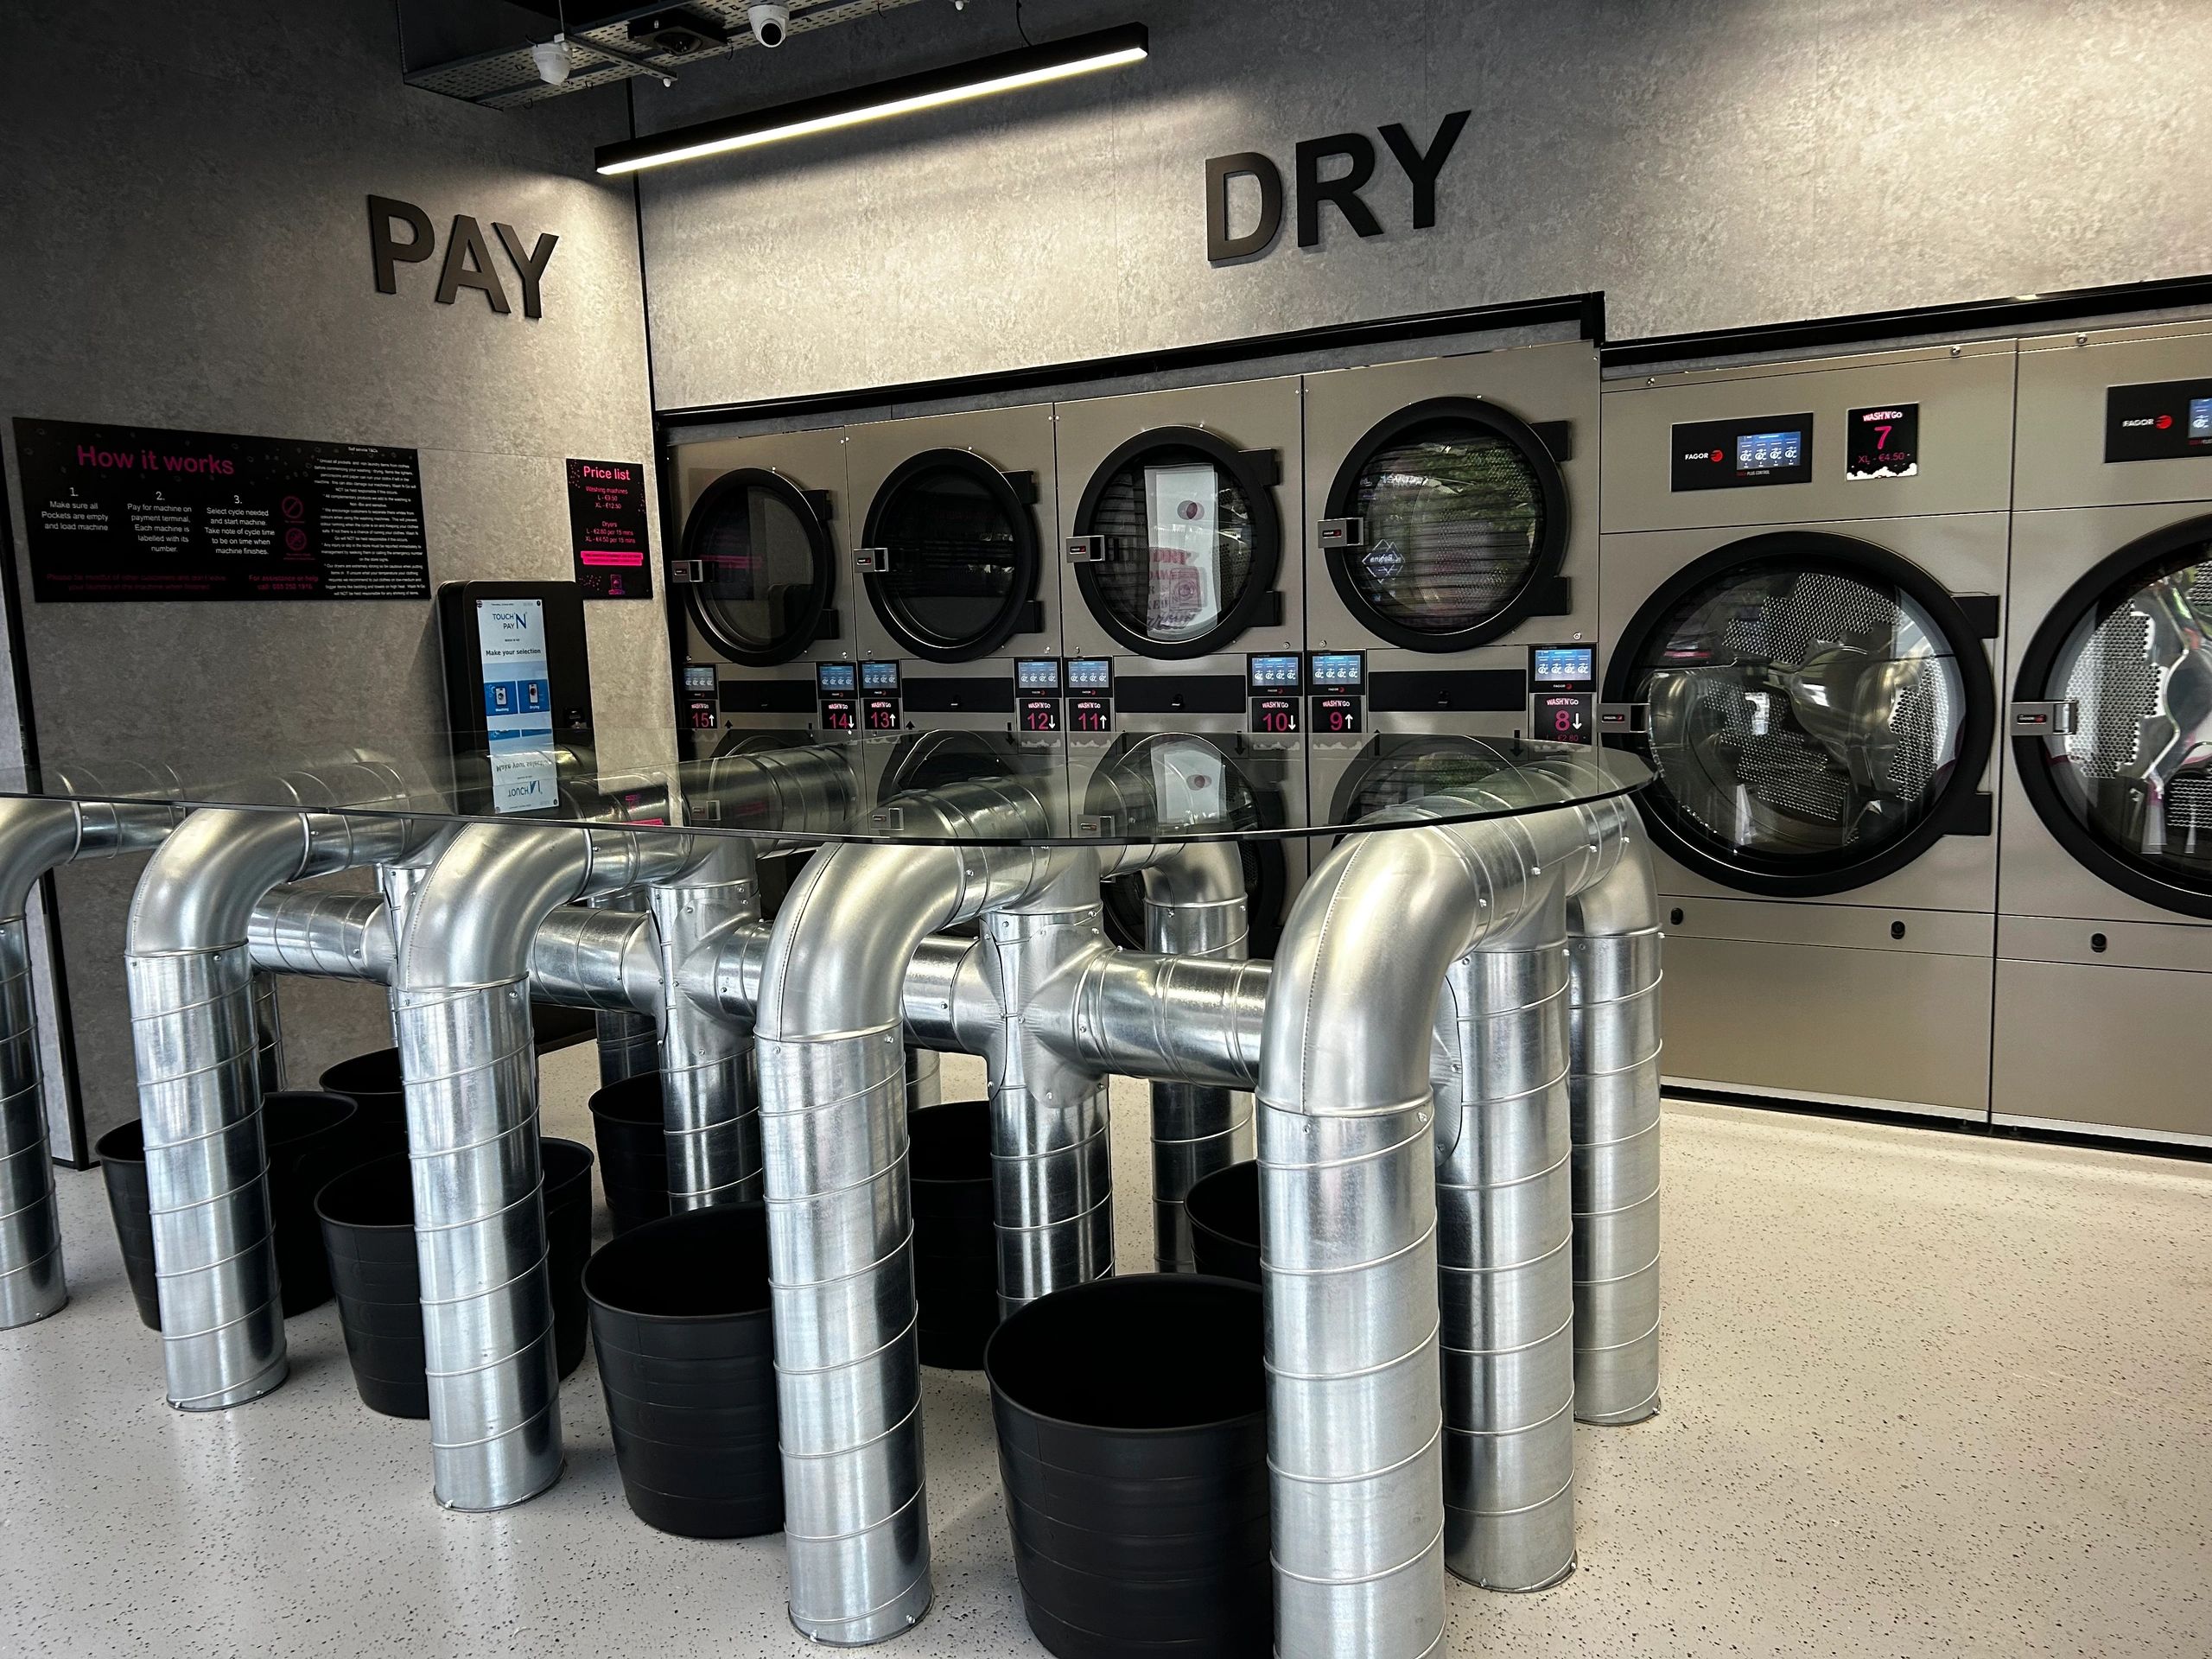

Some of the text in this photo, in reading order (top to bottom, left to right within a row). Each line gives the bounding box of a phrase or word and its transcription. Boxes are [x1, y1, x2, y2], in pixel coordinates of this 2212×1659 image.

[1206, 110, 1471, 266] DRY
[367, 194, 560, 318] PAY
[2122, 418, 2154, 428] FAGOR
[1874, 426, 1892, 449] 7
[76, 445, 234, 474] How it works
[1878, 452, 1905, 462] €4.50
[583, 466, 631, 480] Price list
[69, 487, 79, 497] 1.
[156, 492, 165, 500] 2.
[49, 500, 71, 509] Make
[233, 495, 243, 505] 3.
[127, 503, 142, 512] Pay
[227, 508, 244, 517] cycle
[245, 508, 269, 517] needed
[41, 512, 71, 520] Pockets
[86, 513, 109, 522] empty
[131, 514, 161, 523] payment
[78, 523, 108, 531] machine
[245, 528, 260, 537] cycle
[692, 712, 709, 728] 15
[830, 713, 848, 728] 14
[870, 712, 890, 728] 13
[1027, 712, 1049, 730] 12
[1078, 712, 1099, 730] 11
[1262, 712, 1288, 731] 10
[1330, 711, 1343, 731] 9
[1555, 709, 1570, 731] 8
